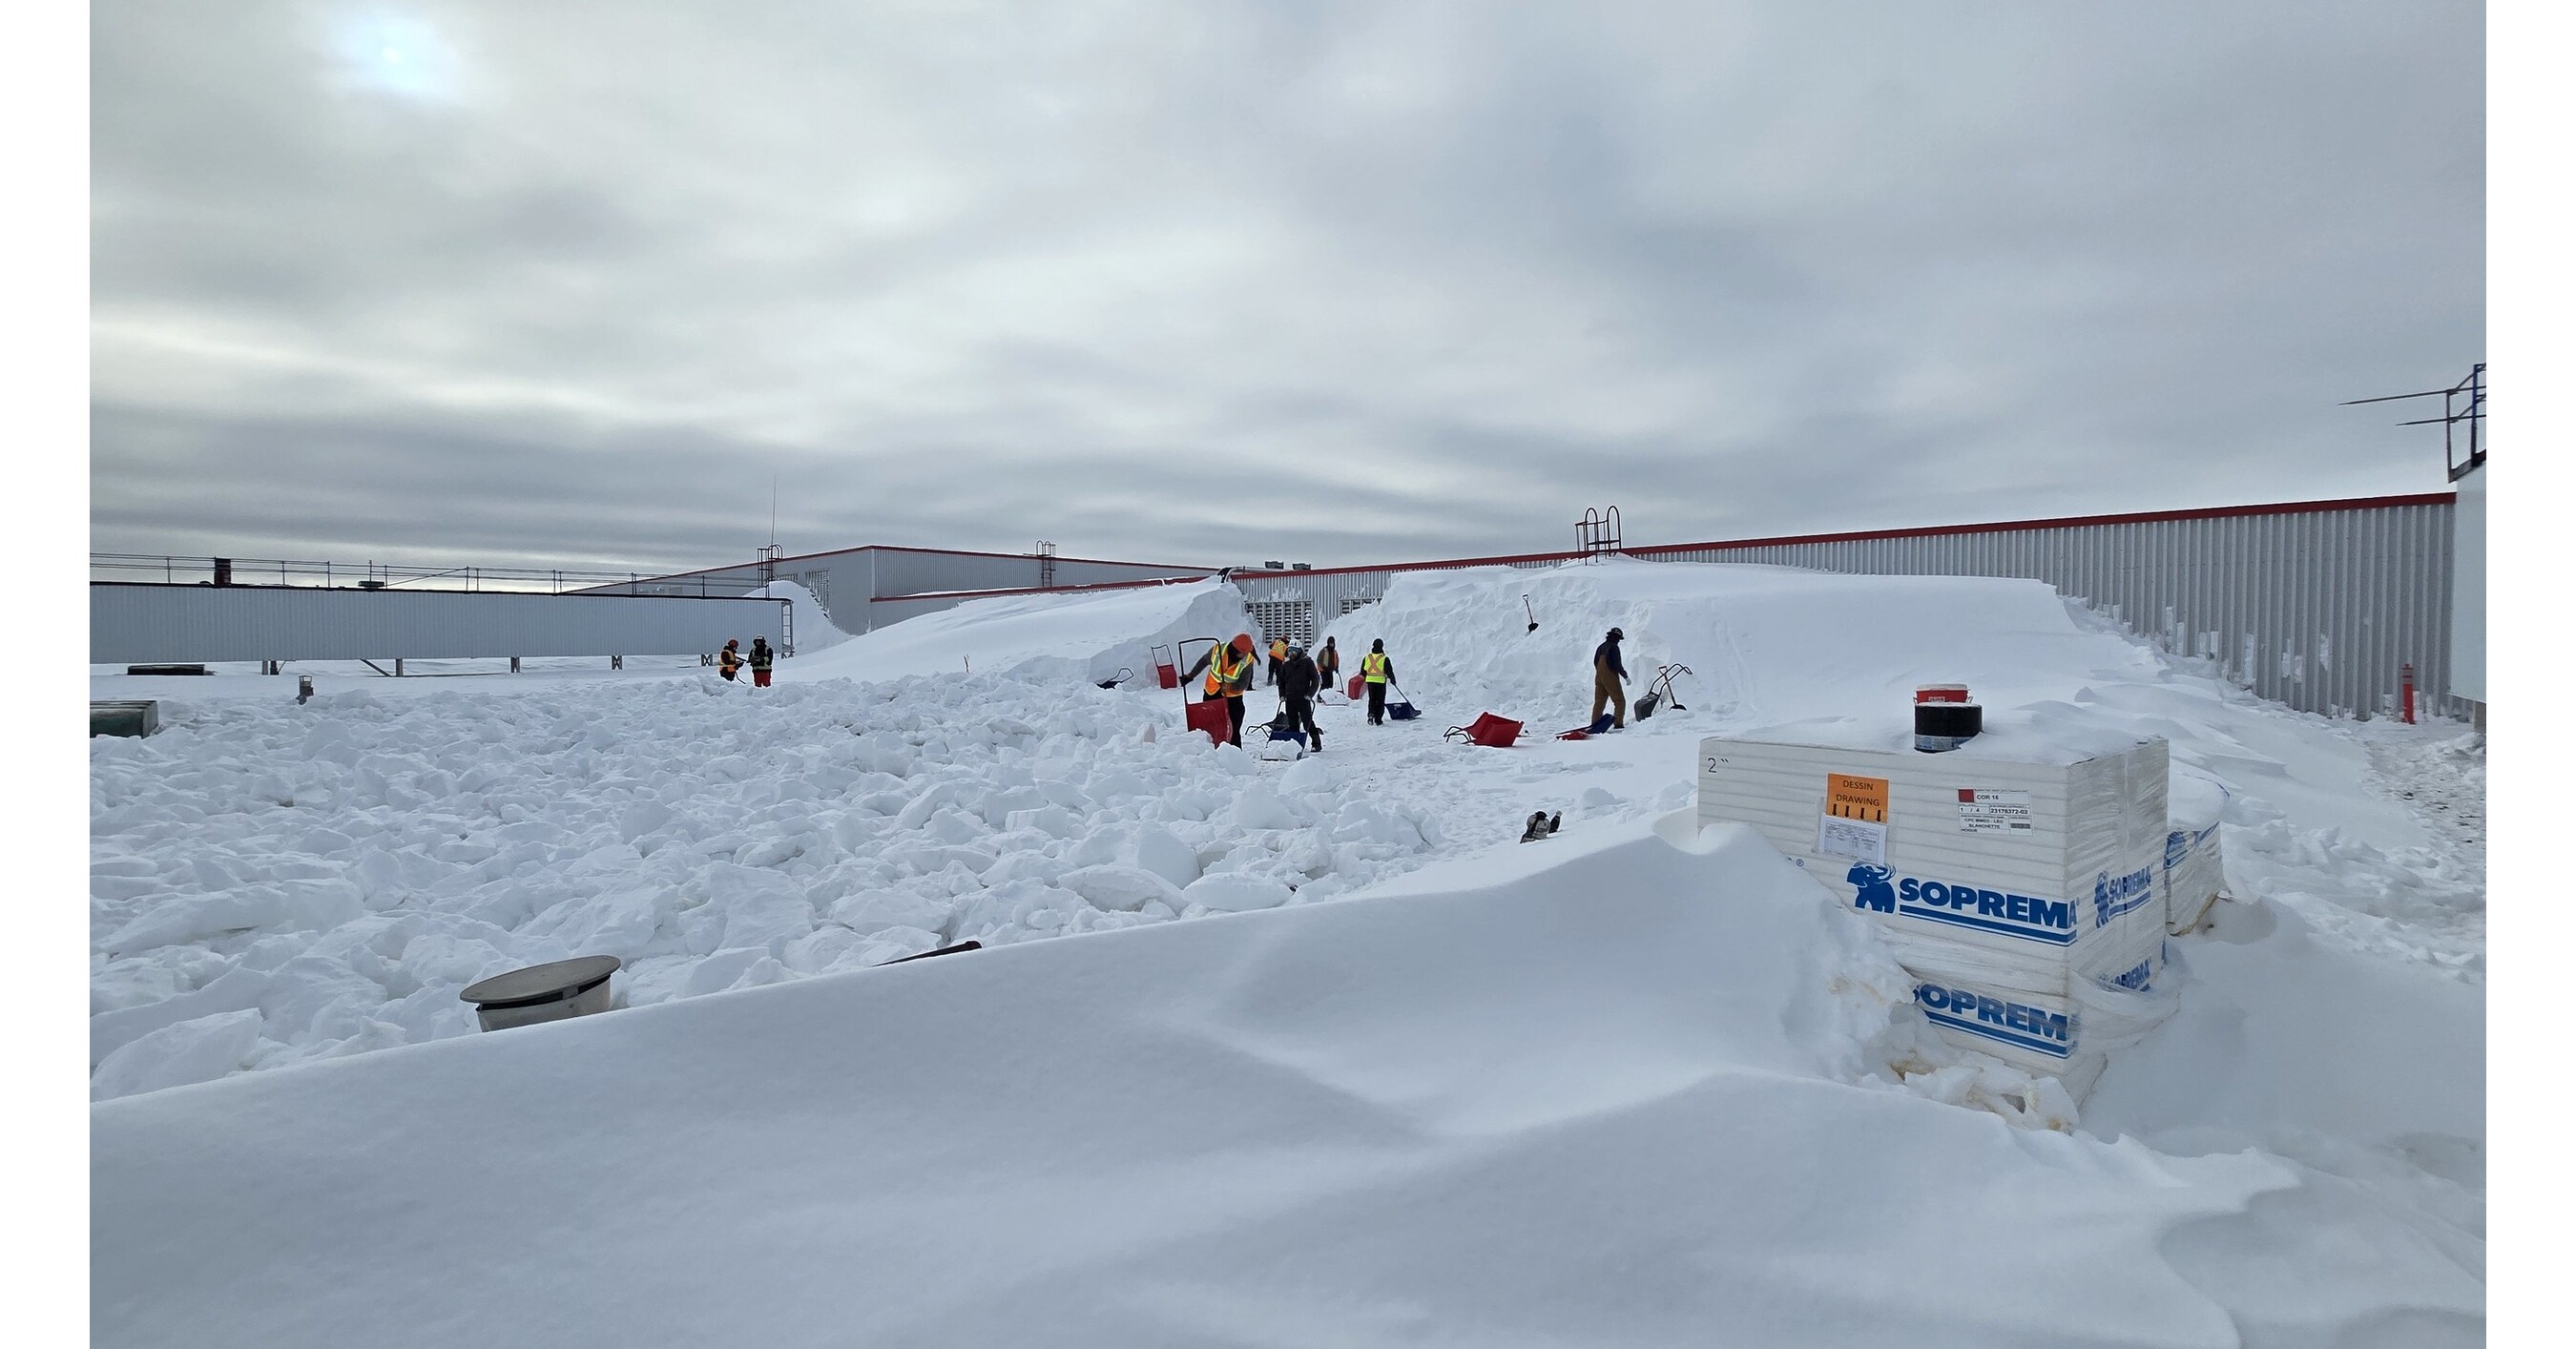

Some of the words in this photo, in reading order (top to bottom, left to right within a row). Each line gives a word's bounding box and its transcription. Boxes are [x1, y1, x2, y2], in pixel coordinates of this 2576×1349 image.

[1836, 793, 1880, 807] DRAWING
[1842, 779, 1874, 791] DESSIN
[2109, 865, 2151, 904] SOPREMA
[1899, 877, 2078, 930] SOPREMA
[2109, 959, 2150, 990] OPREMA
[1912, 983, 2081, 1042] OPREM
